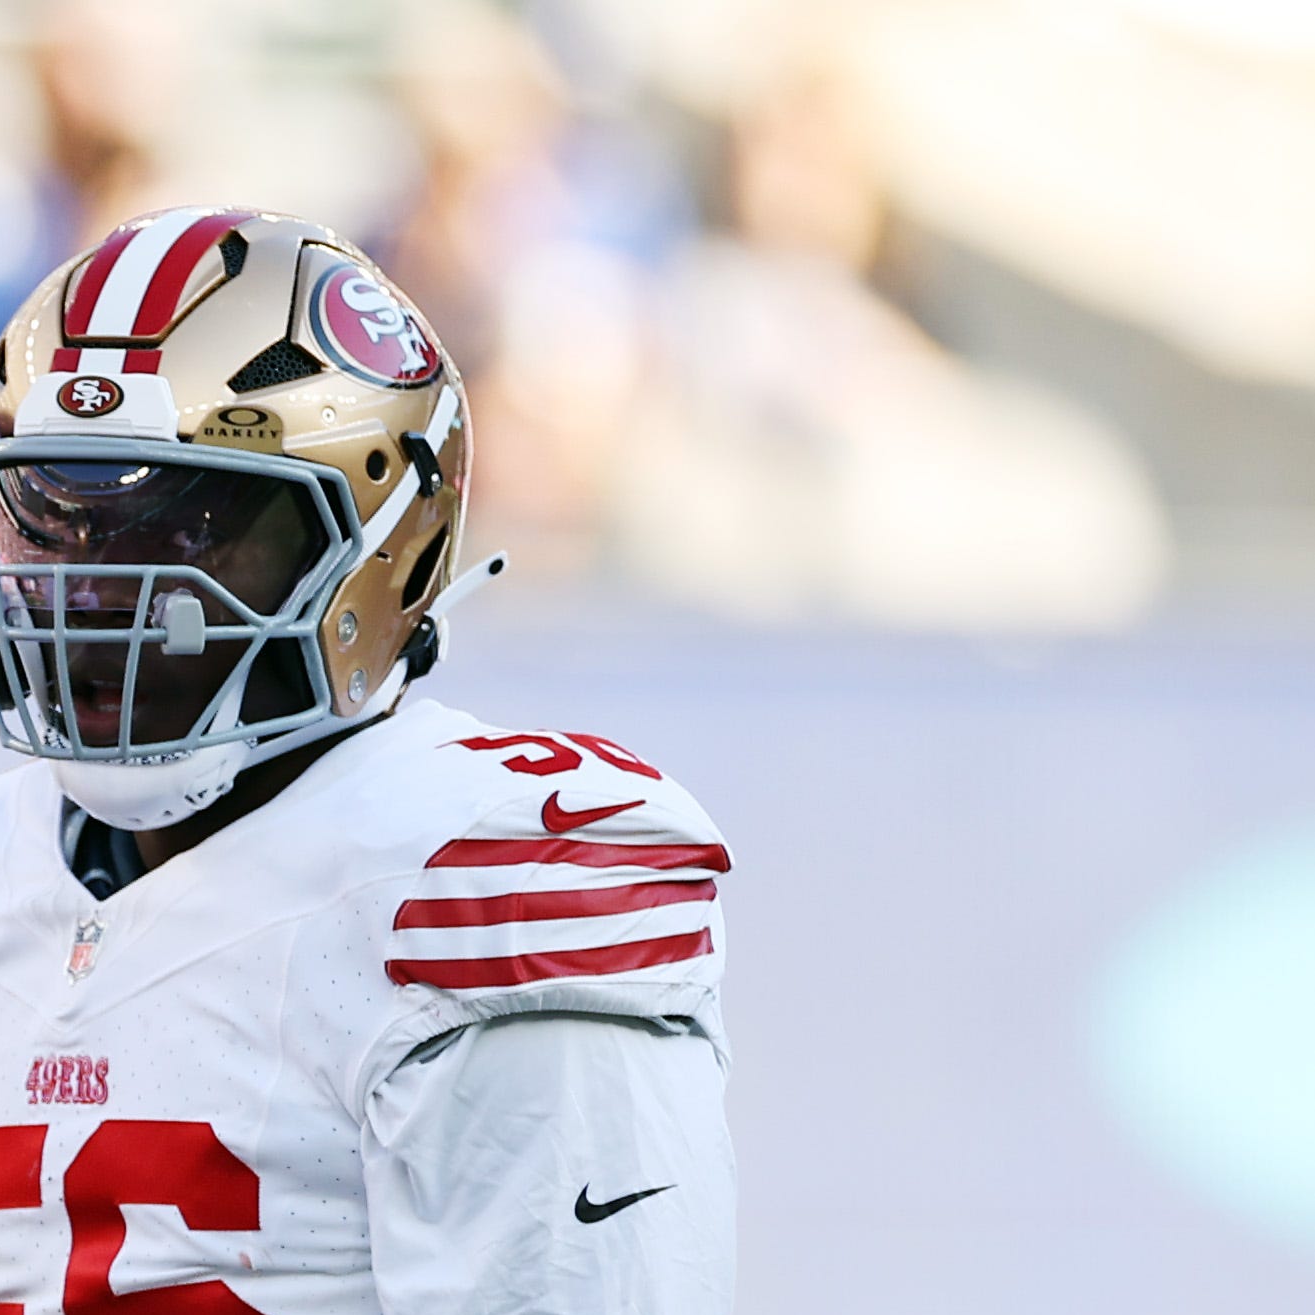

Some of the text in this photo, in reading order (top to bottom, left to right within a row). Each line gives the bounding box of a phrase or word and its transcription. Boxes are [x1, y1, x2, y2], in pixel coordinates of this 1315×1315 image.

[72, 380, 110, 411] SF
[203, 426, 281, 440] OAKLEY
[26, 1055, 108, 1104] 49ERS
